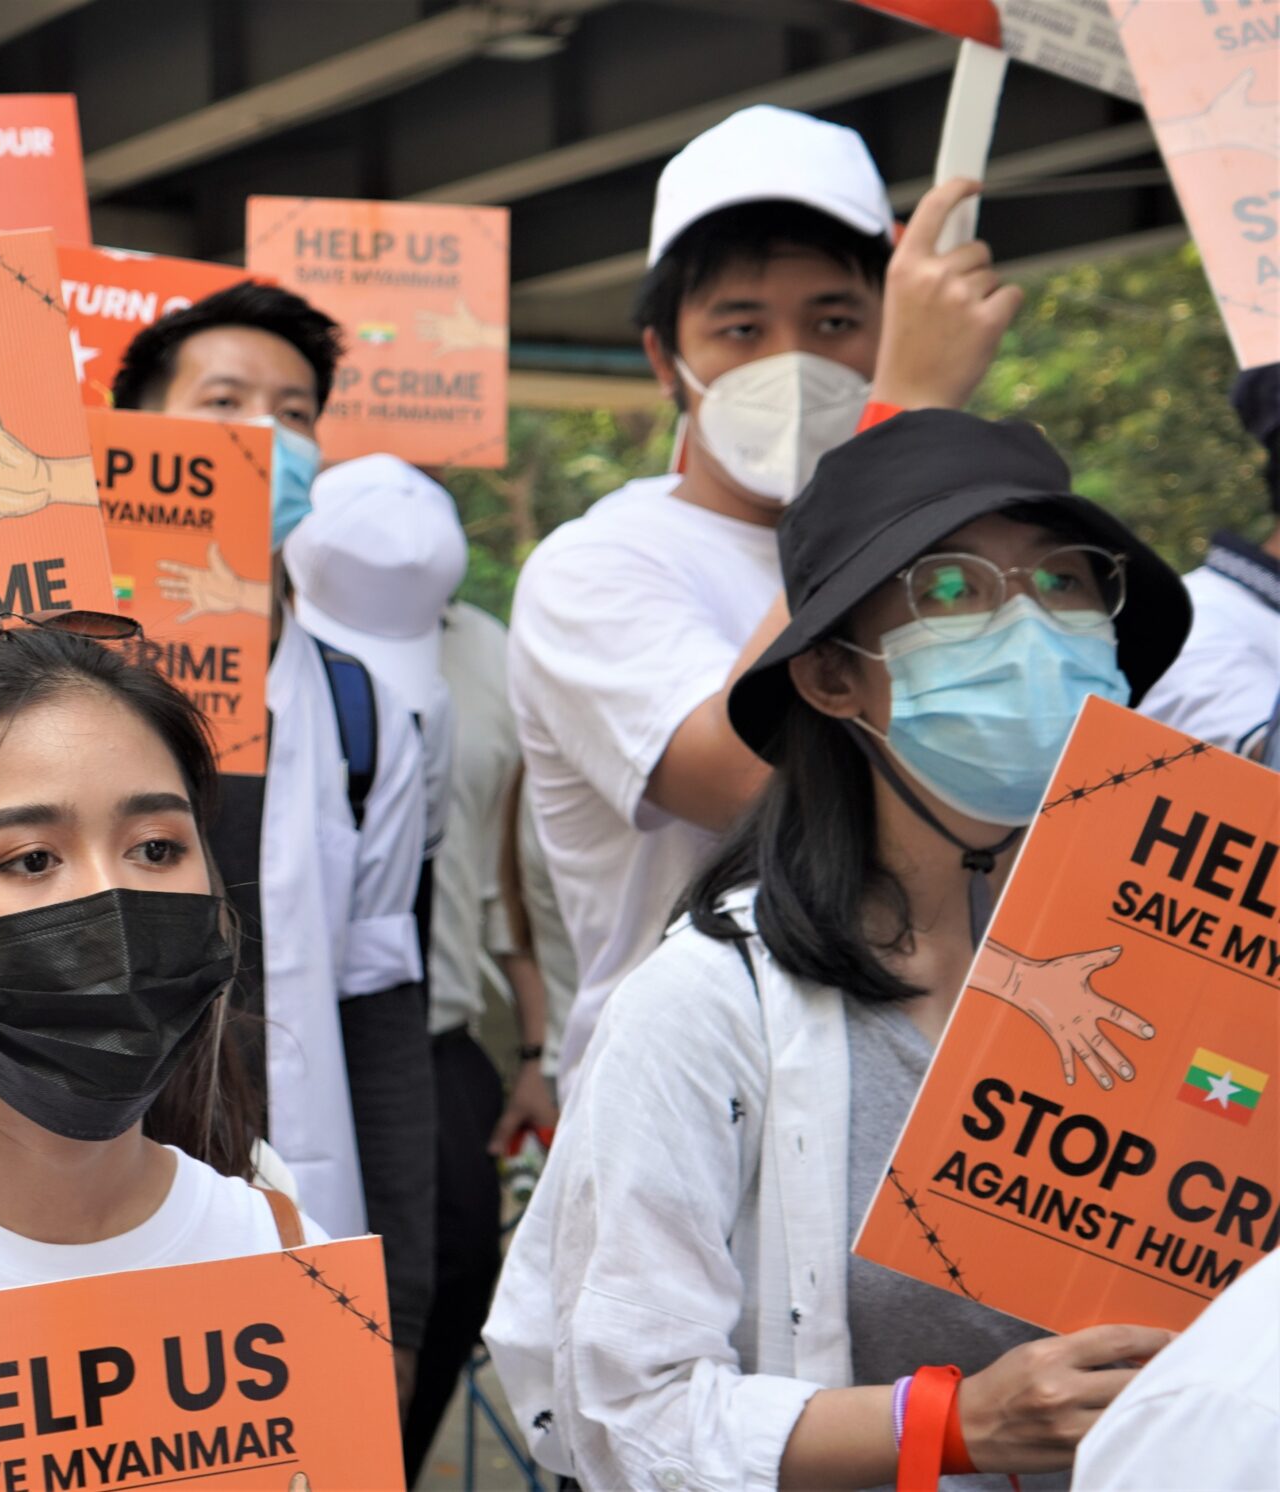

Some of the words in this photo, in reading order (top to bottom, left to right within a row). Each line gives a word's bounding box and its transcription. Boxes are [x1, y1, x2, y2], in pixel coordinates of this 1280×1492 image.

[1214, 15, 1280, 51] SAV
[295, 229, 395, 261] HELP
[406, 234, 460, 266] US
[60, 279, 158, 324] TURN
[371, 368, 483, 400] CRIME
[151, 453, 215, 498] US
[100, 499, 215, 531] YANMAR
[1130, 795, 1280, 919] HEL
[1112, 880, 1221, 950] SAVE
[961, 1077, 1156, 1193] STOP
[1167, 1160, 1280, 1253] CRI
[933, 1150, 1136, 1242] AGAINST
[162, 1322, 290, 1412] US
[42, 1416, 296, 1491] MYANMAR
